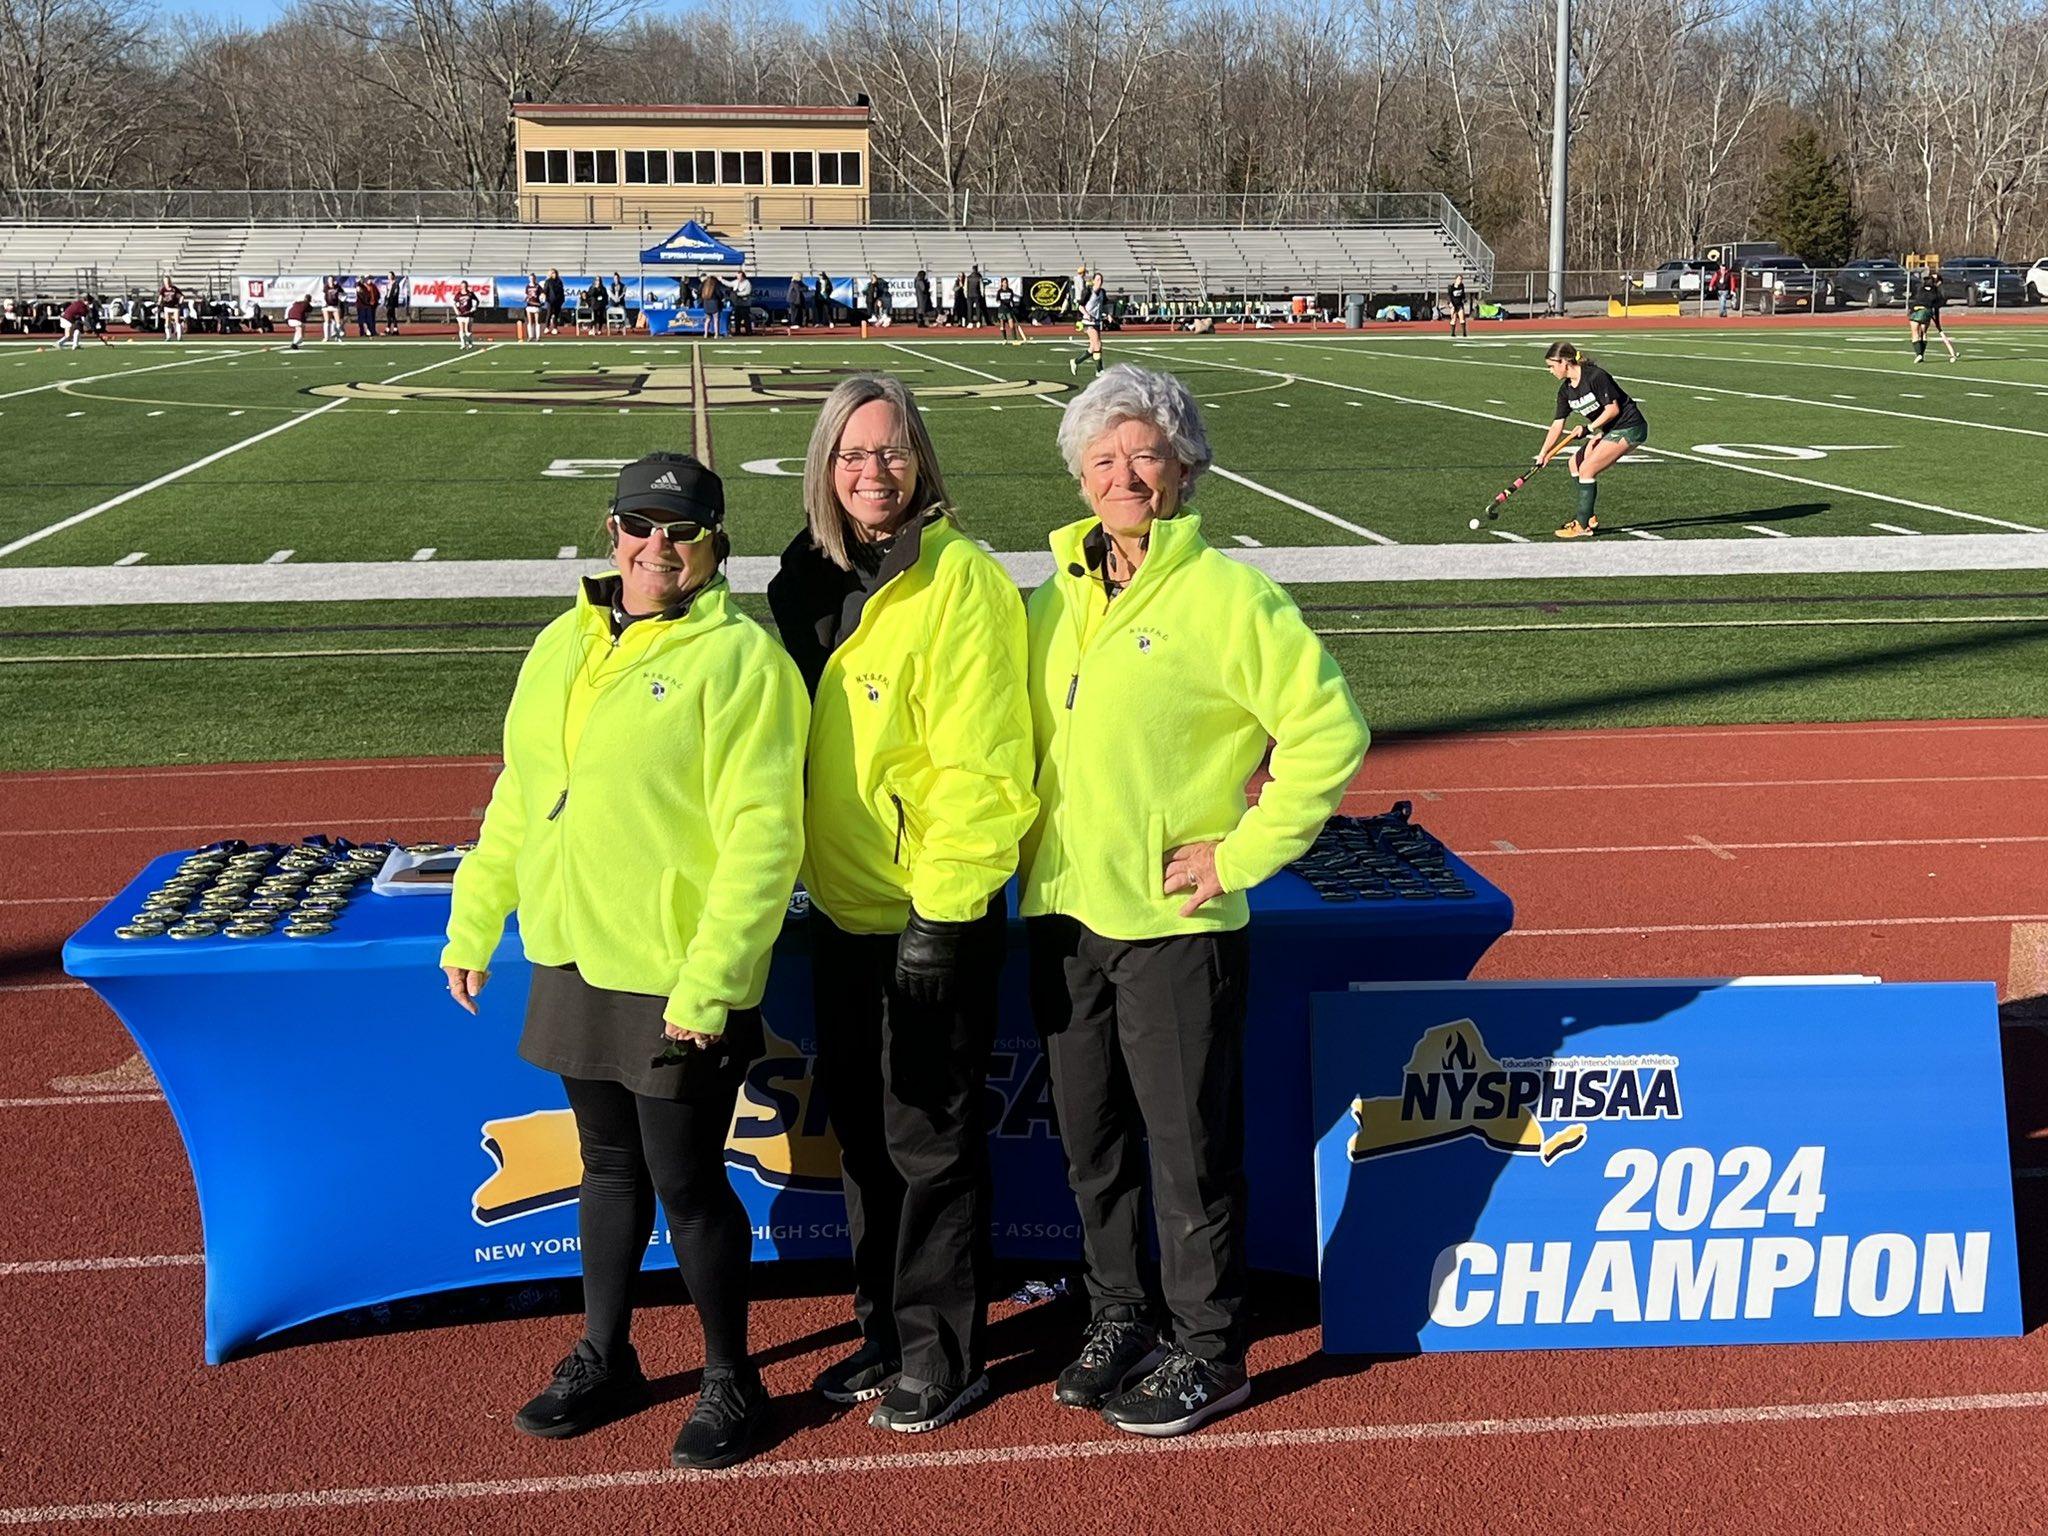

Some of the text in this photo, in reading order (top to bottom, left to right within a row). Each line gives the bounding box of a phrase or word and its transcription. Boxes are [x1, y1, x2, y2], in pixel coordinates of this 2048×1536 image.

[413, 281, 490, 303] MAXPRPS
[650, 483, 682, 491] adidas
[1502, 1057, 1677, 1069] Education Through Interscholastic Athletics
[1401, 1069, 1681, 1121] NYSPHSAA
[1595, 1145, 1826, 1232] 2024
[475, 1243, 526, 1262] NEW
[809, 1224, 850, 1239] SCH
[1006, 1223, 1081, 1238] ASSOCI
[1428, 1231, 1991, 1328] CHAMPION
